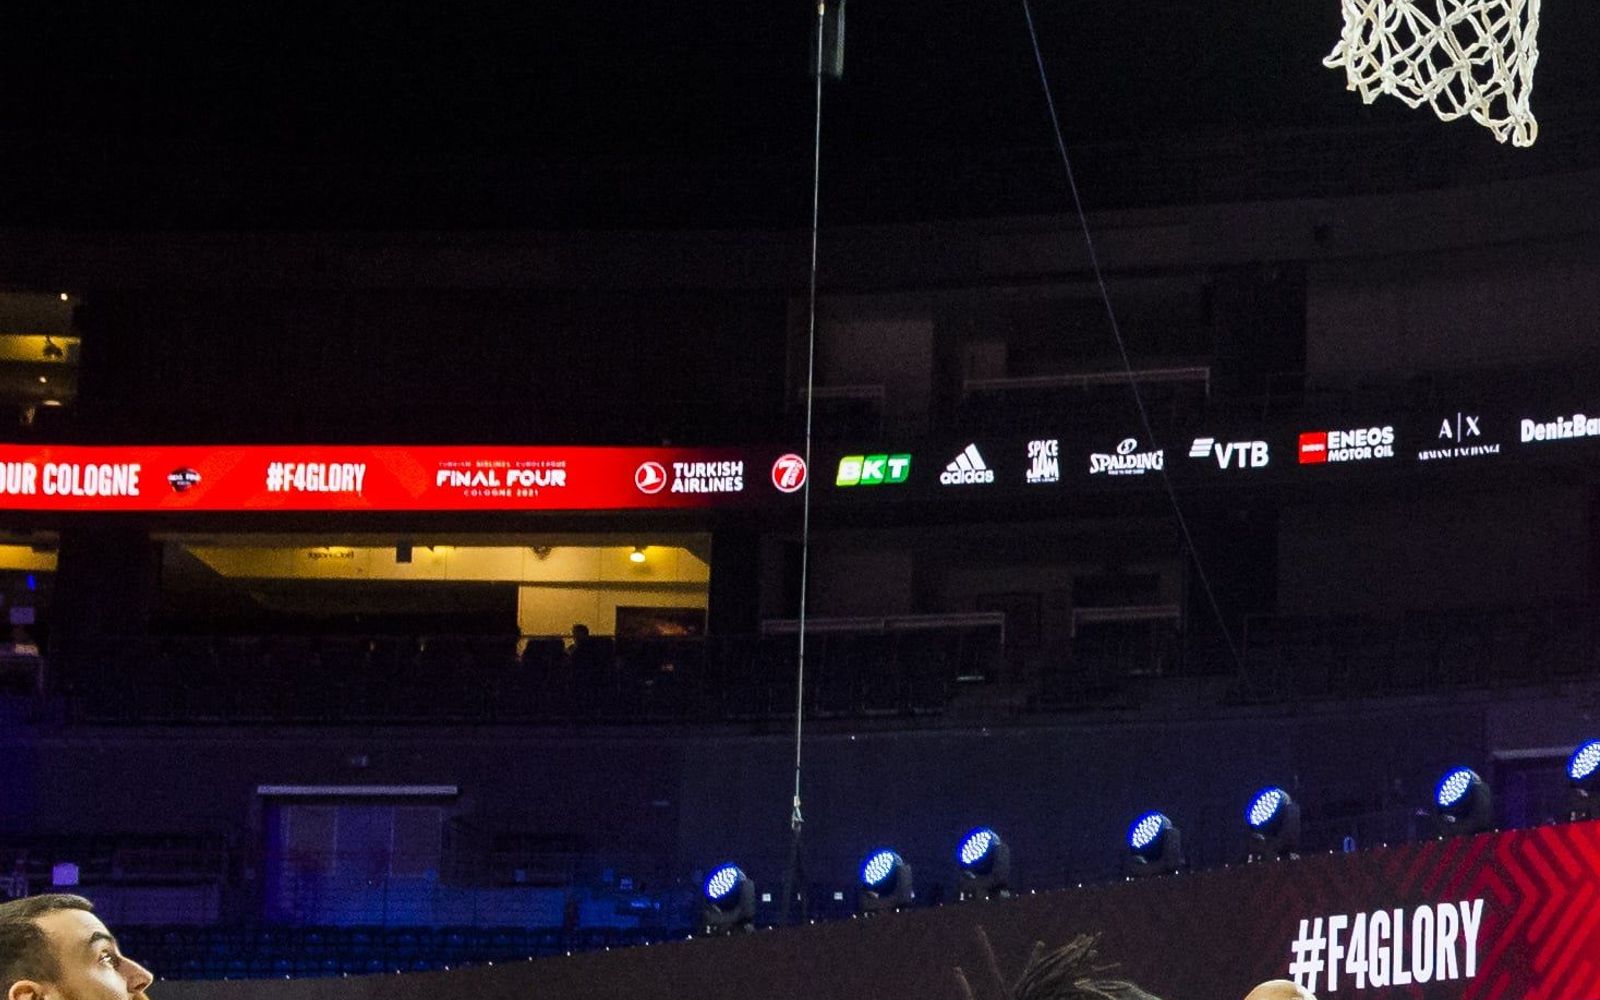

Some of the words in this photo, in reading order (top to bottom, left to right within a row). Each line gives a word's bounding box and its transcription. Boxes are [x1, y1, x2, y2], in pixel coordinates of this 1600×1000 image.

[1028, 440, 1059, 458] SPACE
[1328, 427, 1394, 449] ENEOS
[1090, 450, 1164, 474] SPALDING
[1215, 441, 1269, 469] VTB
[1328, 449, 1372, 463] MOTOR
[1374, 446, 1394, 459] OIL
[436, 468, 500, 487] FINAL
[506, 468, 566, 487] FOUR
[672, 462, 743, 478] TURKISH
[838, 459, 908, 482] BKT
[940, 466, 994, 485] adidas
[1026, 456, 1059, 479] JAM
[43, 464, 141, 497] COLOGNE
[267, 462, 366, 497] #F4GLORY
[671, 476, 743, 493] AIRLINES
[1289, 899, 1484, 994] #F4GLORY
